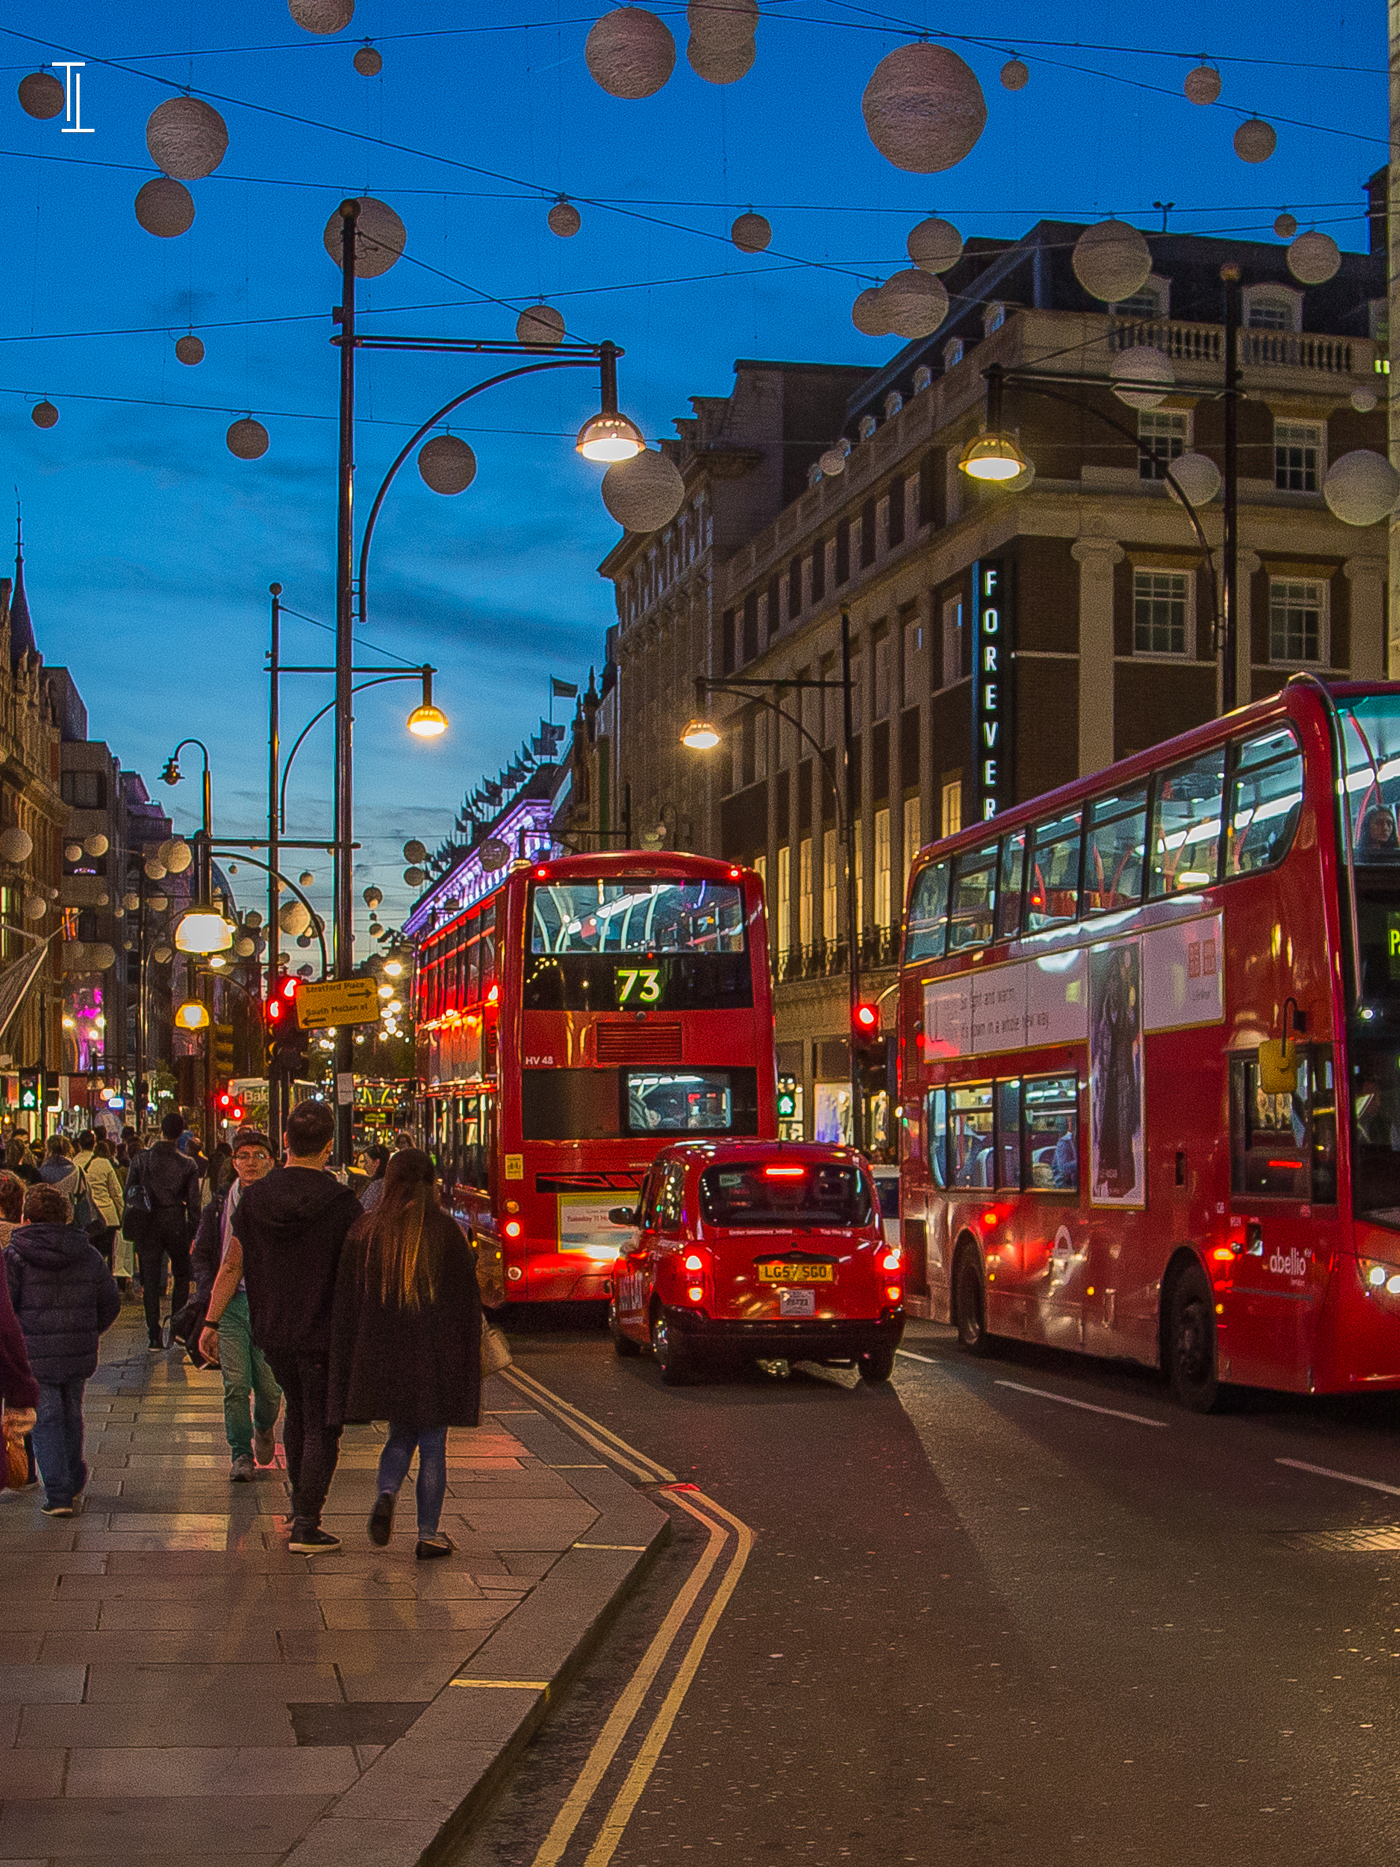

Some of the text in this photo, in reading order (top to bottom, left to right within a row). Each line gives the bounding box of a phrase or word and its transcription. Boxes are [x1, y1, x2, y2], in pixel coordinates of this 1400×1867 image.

[983, 569, 999, 822] FOREVER
[617, 968, 661, 1003] 73
[525, 1055, 555, 1066] HV 48
[1269, 1246, 1307, 1276] abellio
